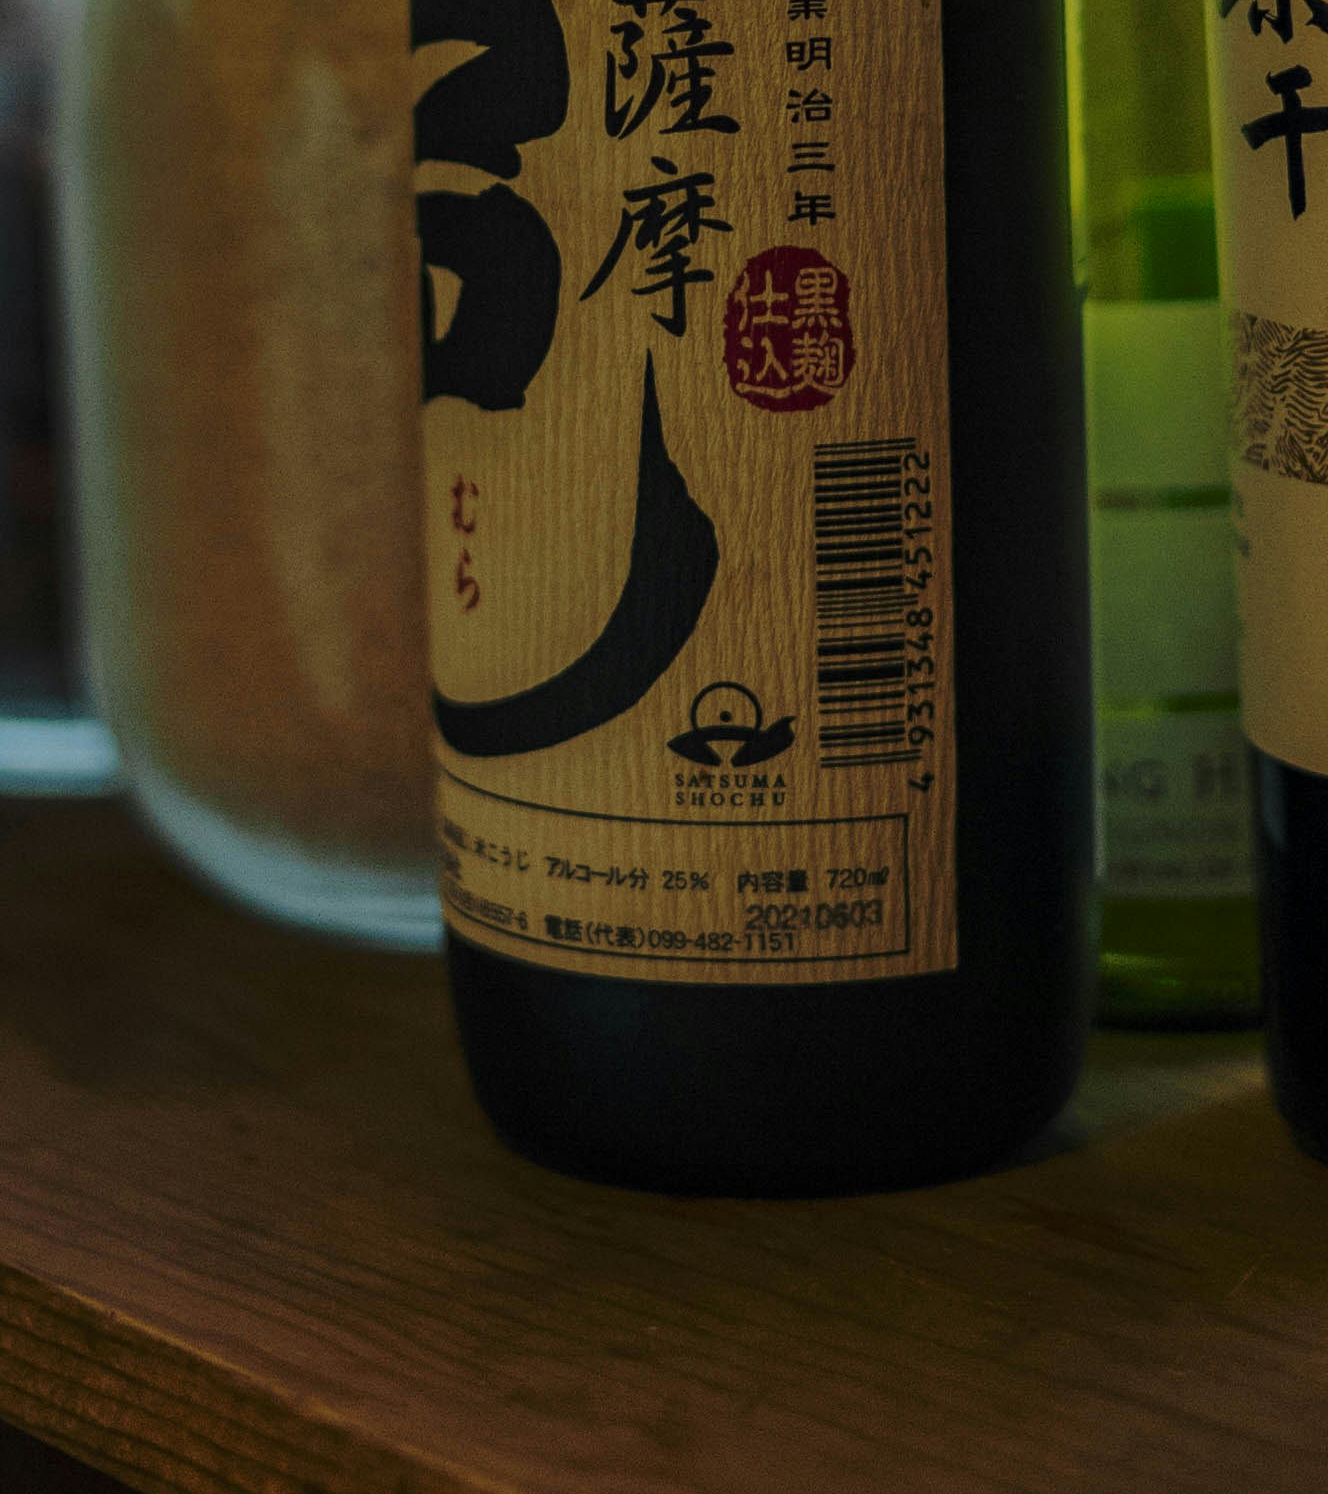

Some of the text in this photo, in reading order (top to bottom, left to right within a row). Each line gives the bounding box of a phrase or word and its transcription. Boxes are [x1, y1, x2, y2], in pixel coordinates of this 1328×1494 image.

[449, 471, 482, 612] むら
[674, 773, 787, 789] SATSUMA
[674, 791, 787, 807] SHOCHU
[544, 854, 650, 891] アルコール分
[661, 869, 711, 891] 25%
[736, 868, 810, 894] 内容量
